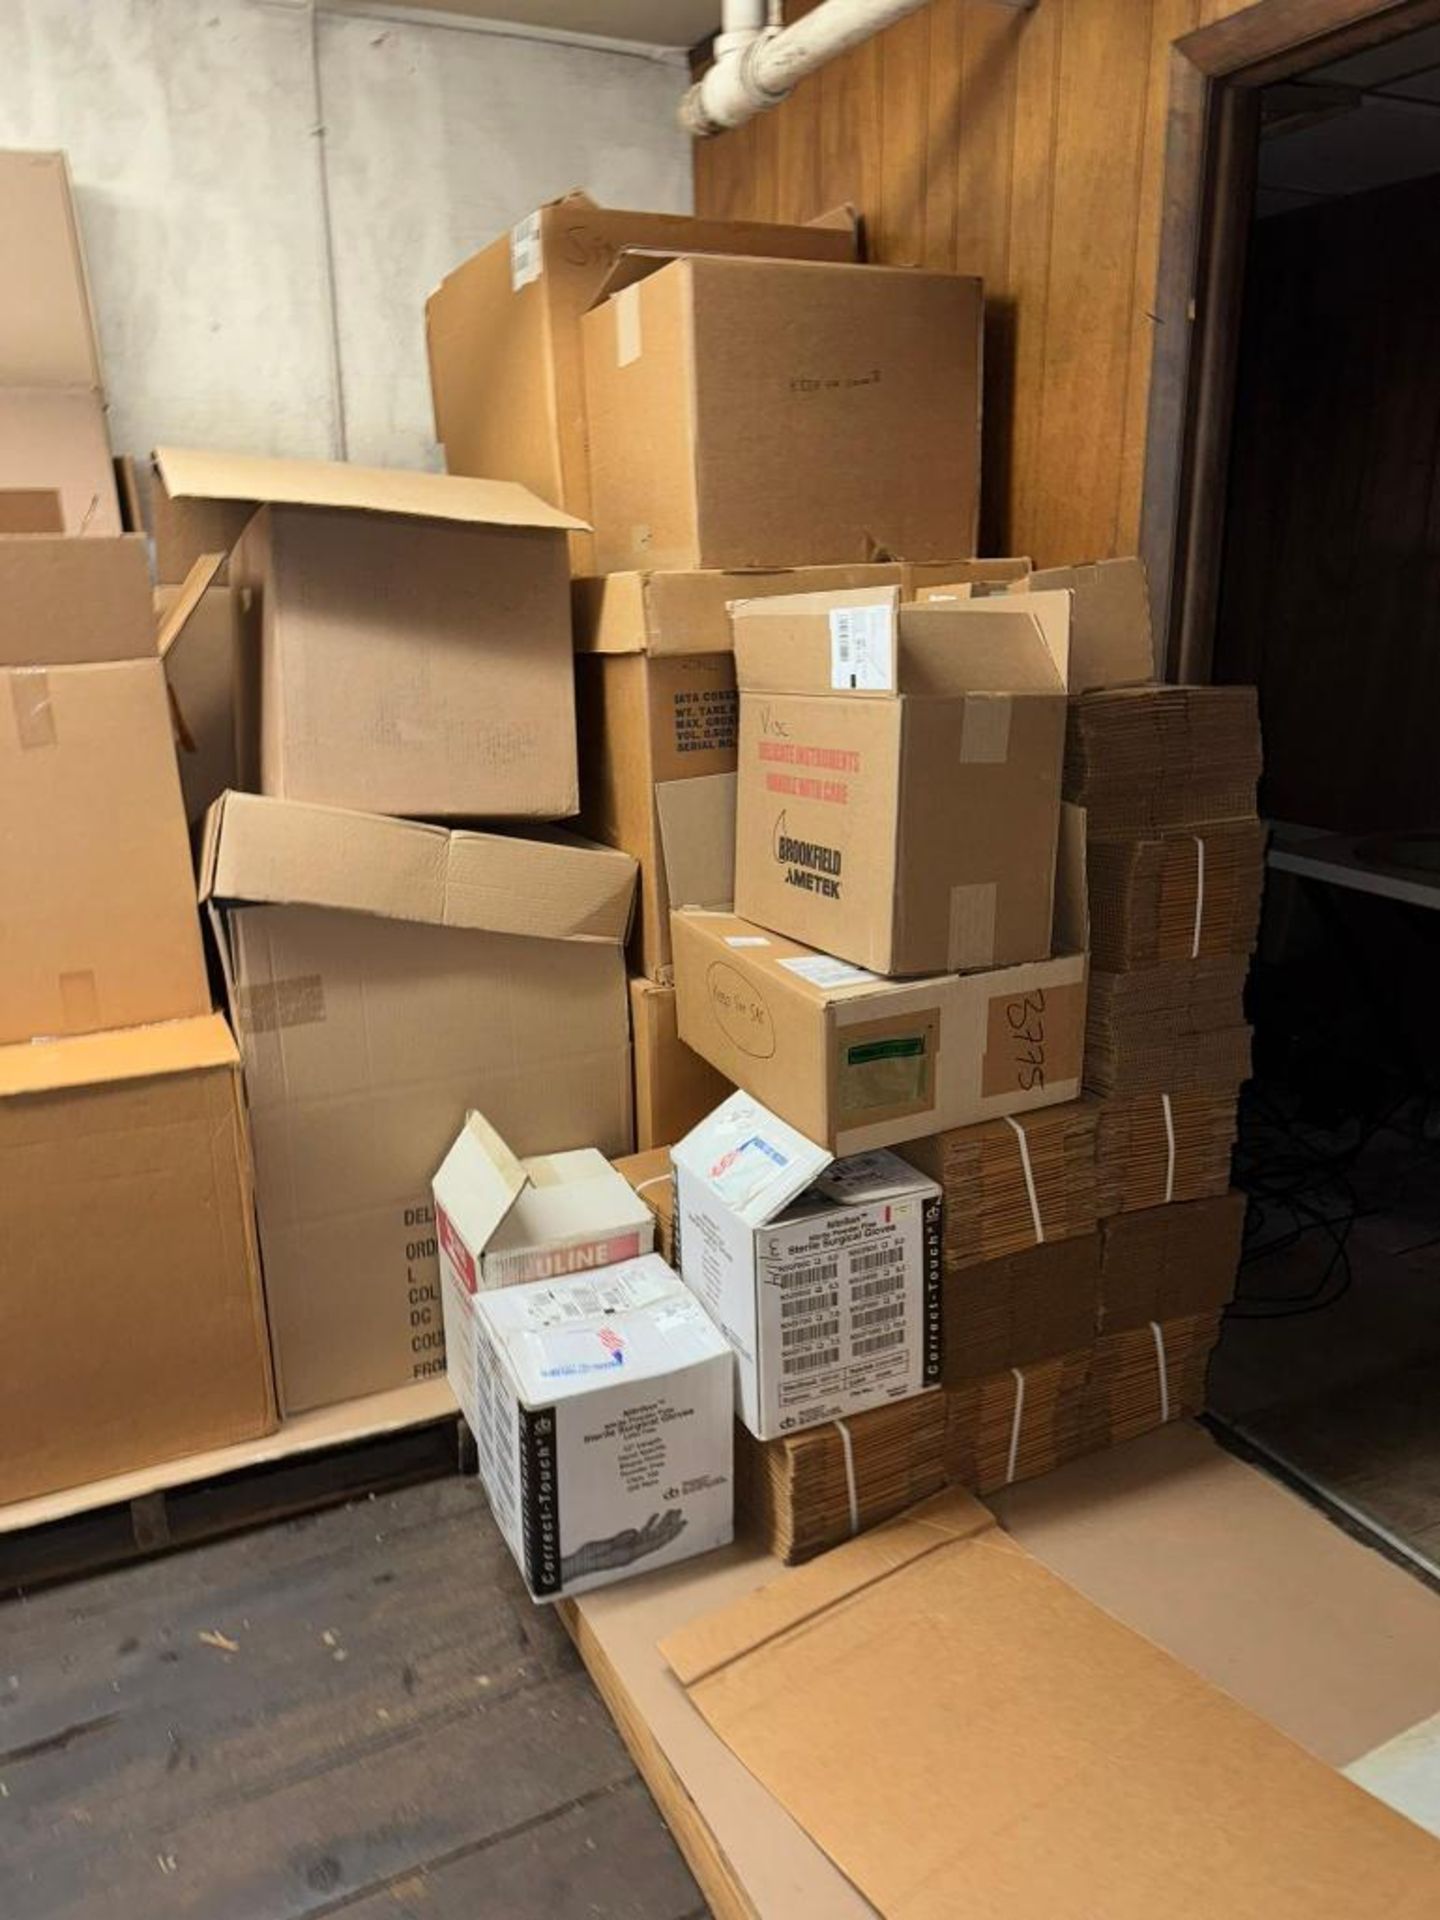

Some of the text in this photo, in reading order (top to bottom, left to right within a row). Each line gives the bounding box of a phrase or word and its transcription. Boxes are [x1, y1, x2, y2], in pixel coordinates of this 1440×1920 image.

[779, 836, 842, 877] BROOKFIELD
[785, 868, 841, 900] AMETEK
[404, 1205, 436, 1227] DEL
[822, 1231, 863, 1248] Surgical
[864, 1224, 897, 1238] Gloves
[406, 1238, 438, 1261] ORD
[536, 1243, 609, 1273] ULINE
[407, 1266, 417, 1283] L
